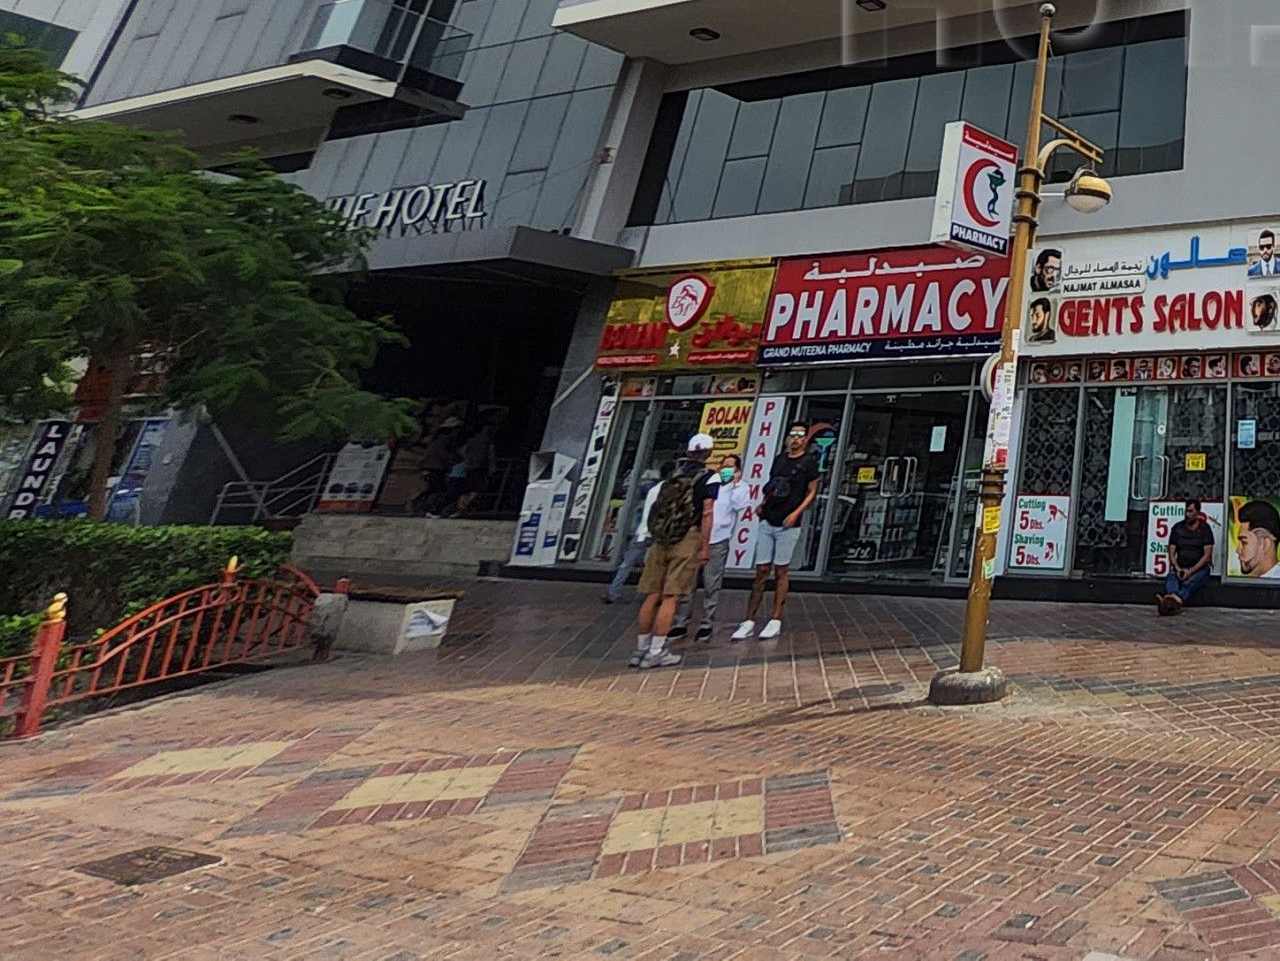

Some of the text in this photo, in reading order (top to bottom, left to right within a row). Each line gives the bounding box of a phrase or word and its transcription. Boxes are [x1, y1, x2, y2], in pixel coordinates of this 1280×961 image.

[370, 179, 487, 228] HOTEL
[951, 225, 1005, 251] PHARMACY
[1093, 261, 1119, 273] المساء
[1121, 259, 1142, 273] نجمة
[1145, 236, 1248, 280] صالون
[803, 254, 987, 284] صيدلية
[1062, 279, 1140, 293] NAJMAT ALMASAA
[766, 277, 1009, 341] PHARMACY
[1057, 289, 1244, 337] GENTS SALON
[763, 346, 790, 358] GRAND
[790, 344, 826, 357] MUTEENA
[827, 341, 872, 355] PHARMACY
[706, 405, 751, 425] BOLAN
[708, 427, 742, 440] MOBILE
[7, 424, 63, 520] LAUNDR
[734, 401, 776, 567] PHARMACY
[1017, 498, 1047, 511] Cutting
[1152, 504, 1185, 516] Cuttin
[1019, 510, 1030, 530] 5
[1030, 518, 1045, 530] Dhs.
[1155, 517, 1169, 539] 5
[1014, 533, 1045, 547] Shaving
[1015, 546, 1026, 565] 5
[1153, 554, 1168, 575] 5
